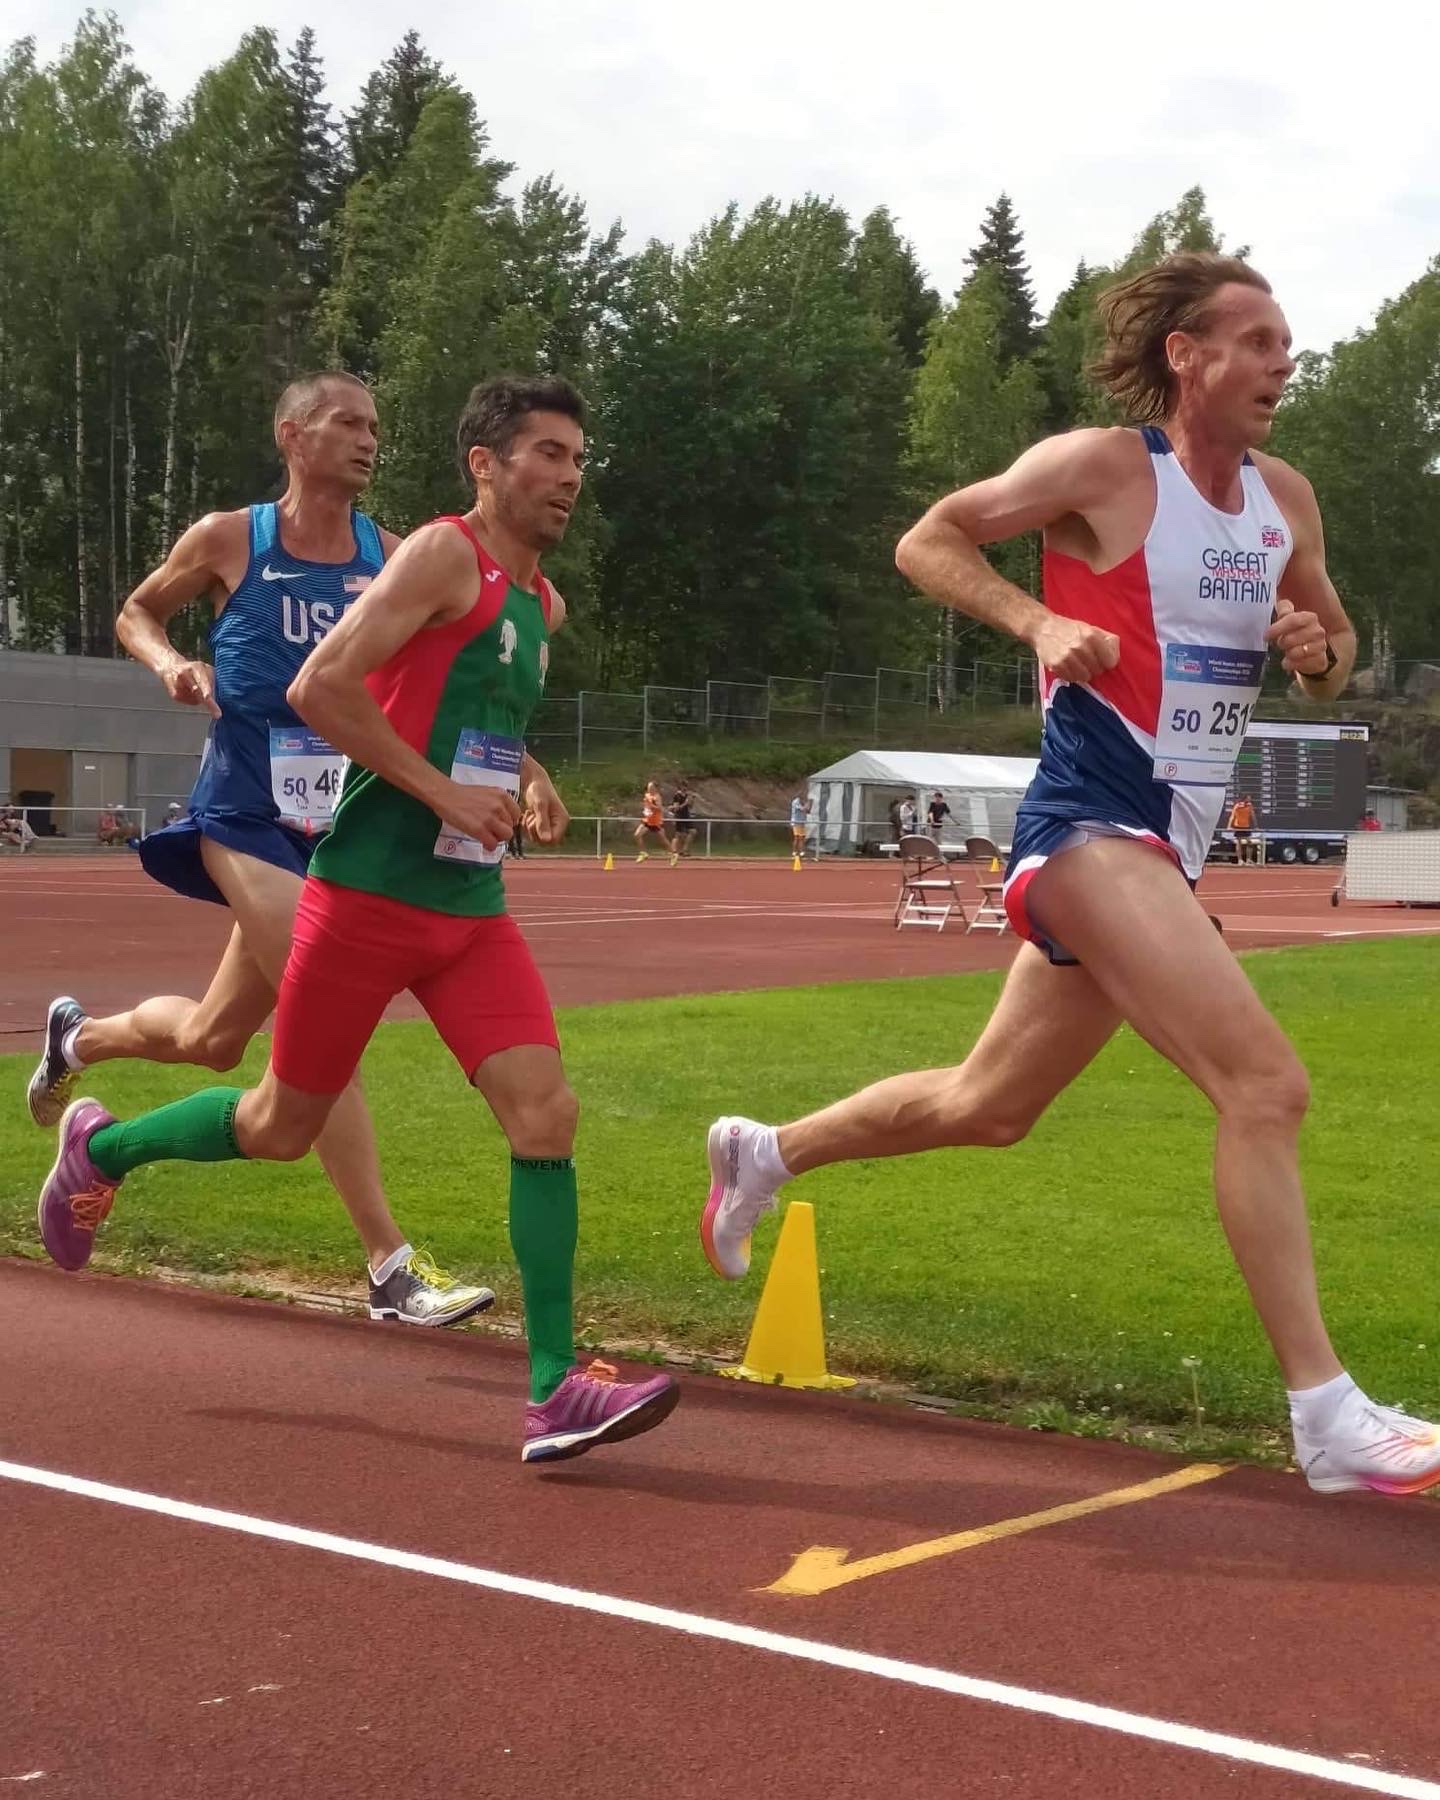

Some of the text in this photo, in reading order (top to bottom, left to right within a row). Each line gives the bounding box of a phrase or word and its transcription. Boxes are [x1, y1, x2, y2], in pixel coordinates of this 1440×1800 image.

[1202, 549, 1269, 574] GREAT
[1211, 566, 1262, 580] MASTERS
[1199, 576, 1271, 603] BRITAIN
[283, 596, 353, 644] US
[1171, 701, 1253, 736] 50 251
[283, 777, 307, 796] 50
